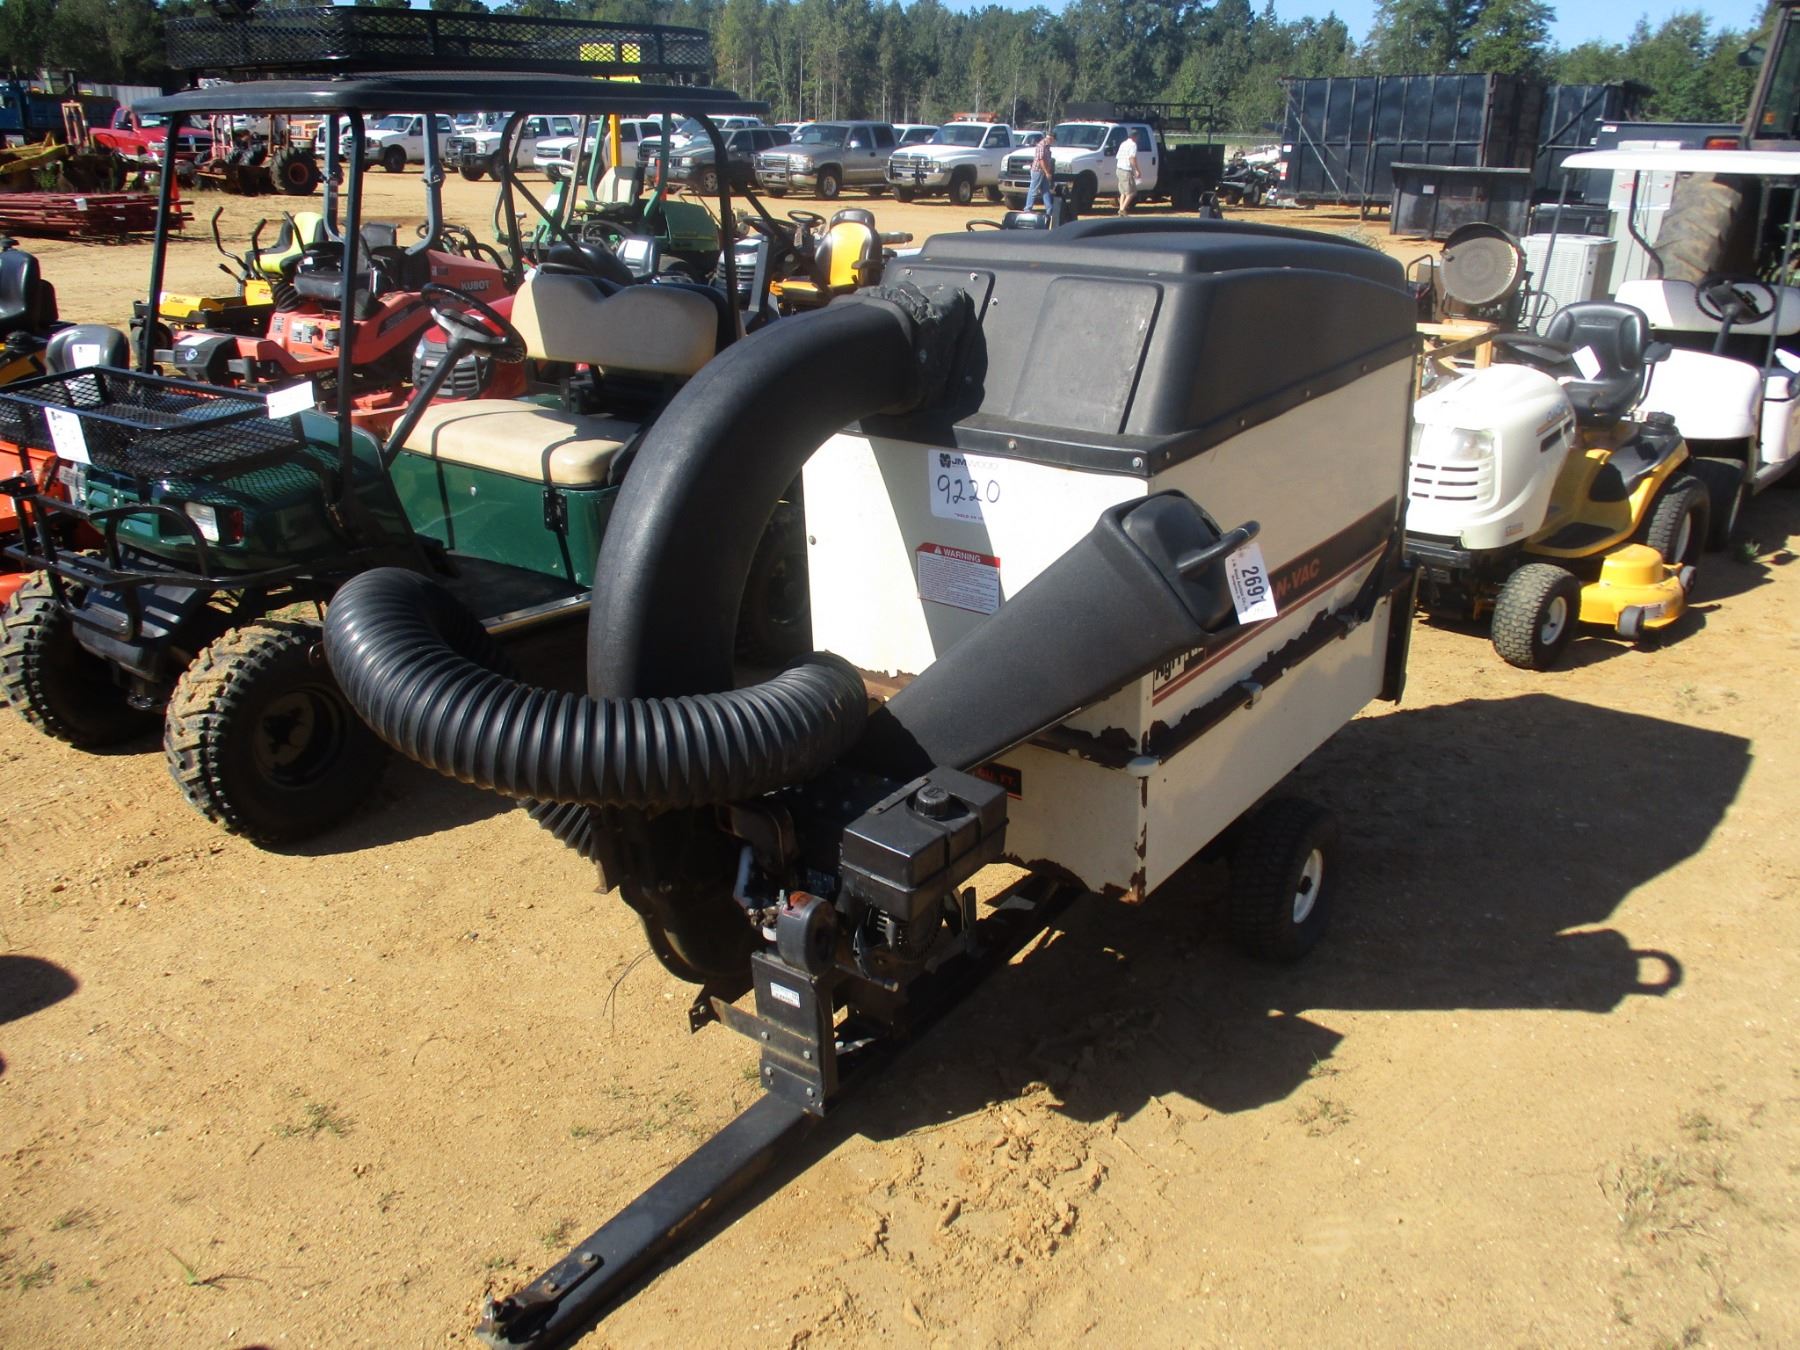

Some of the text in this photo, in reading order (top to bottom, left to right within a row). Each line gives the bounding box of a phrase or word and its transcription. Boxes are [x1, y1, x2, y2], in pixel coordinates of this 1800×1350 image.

[937, 474, 1001, 505] 9220
[943, 547, 981, 563] WARNING
[1241, 566, 1267, 606] 2691
